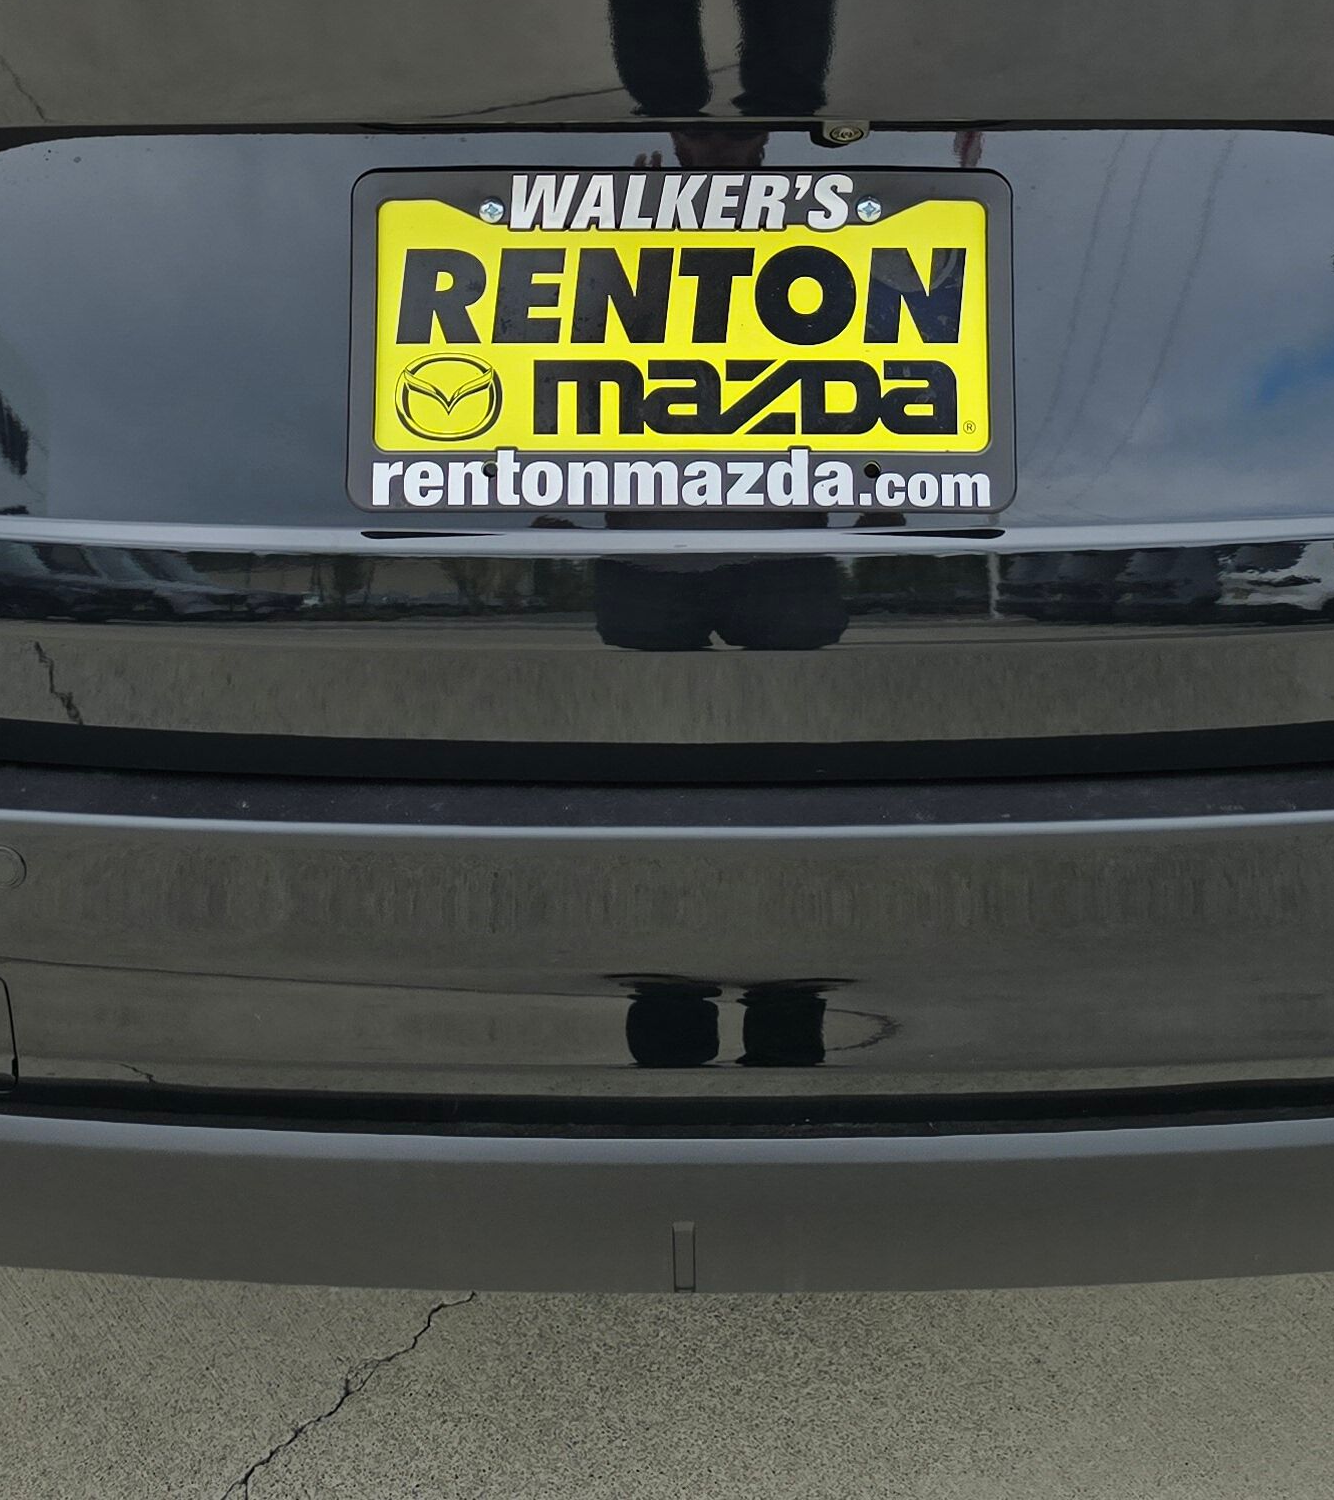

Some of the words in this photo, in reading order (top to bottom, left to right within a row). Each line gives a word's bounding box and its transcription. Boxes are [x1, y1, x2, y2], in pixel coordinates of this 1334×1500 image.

[508, 173, 855, 232] WALKER'S
[395, 245, 968, 346] RENTON
[371, 448, 993, 509] rentonmazda.com
